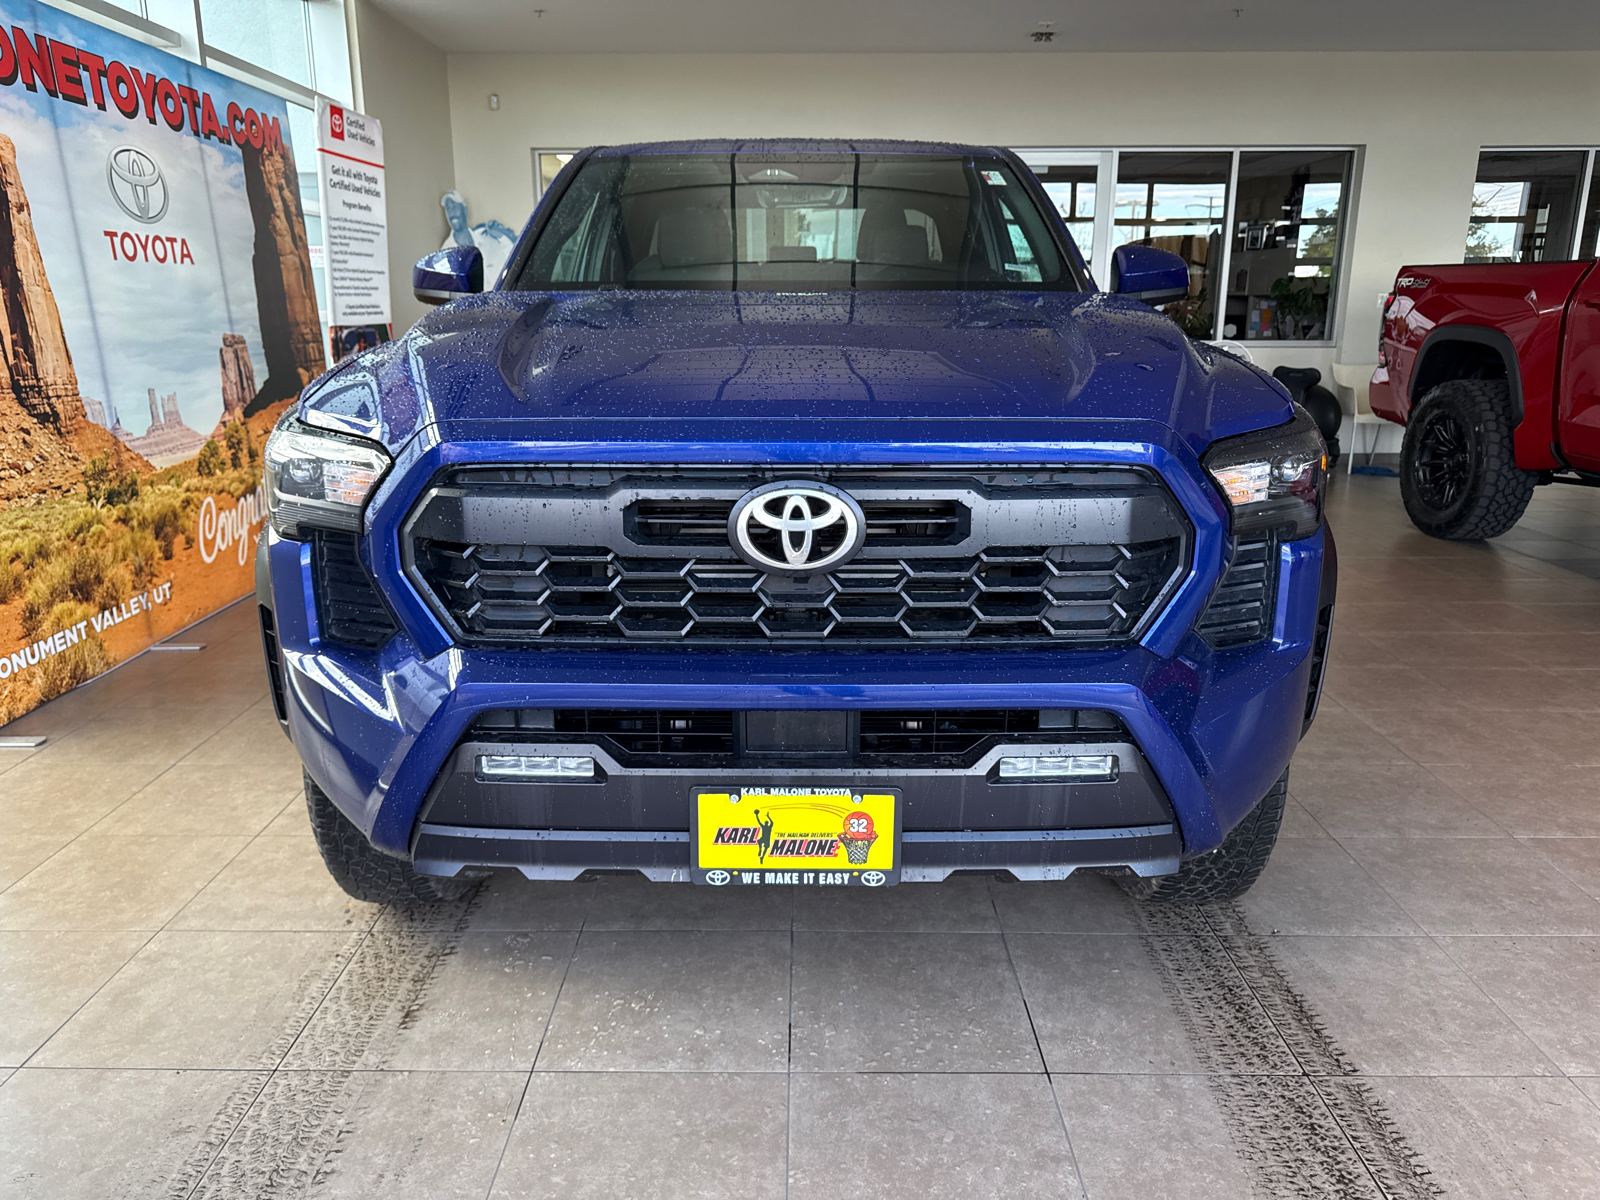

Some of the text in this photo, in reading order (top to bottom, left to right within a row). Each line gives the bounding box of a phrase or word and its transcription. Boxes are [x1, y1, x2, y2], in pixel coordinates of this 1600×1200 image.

[346, 116, 365, 131] Certified
[347, 128, 376, 147] Used Vehicles
[331, 165, 341, 176] Get
[353, 170, 363, 181] with
[363, 172, 378, 185] Toyota
[329, 178, 381, 198] Certified Used Vehicles
[103, 230, 195, 265] TOYOTA
[90, 592, 153, 633] VALLEY,
[152, 582, 172, 605] UT
[741, 788, 851, 797] KARL MALONE TOYOTA
[849, 818, 868, 833] 32
[713, 827, 761, 845] KARL
[768, 839, 840, 857] MALONE
[741, 872, 850, 884] WE MAKE IT EASY
